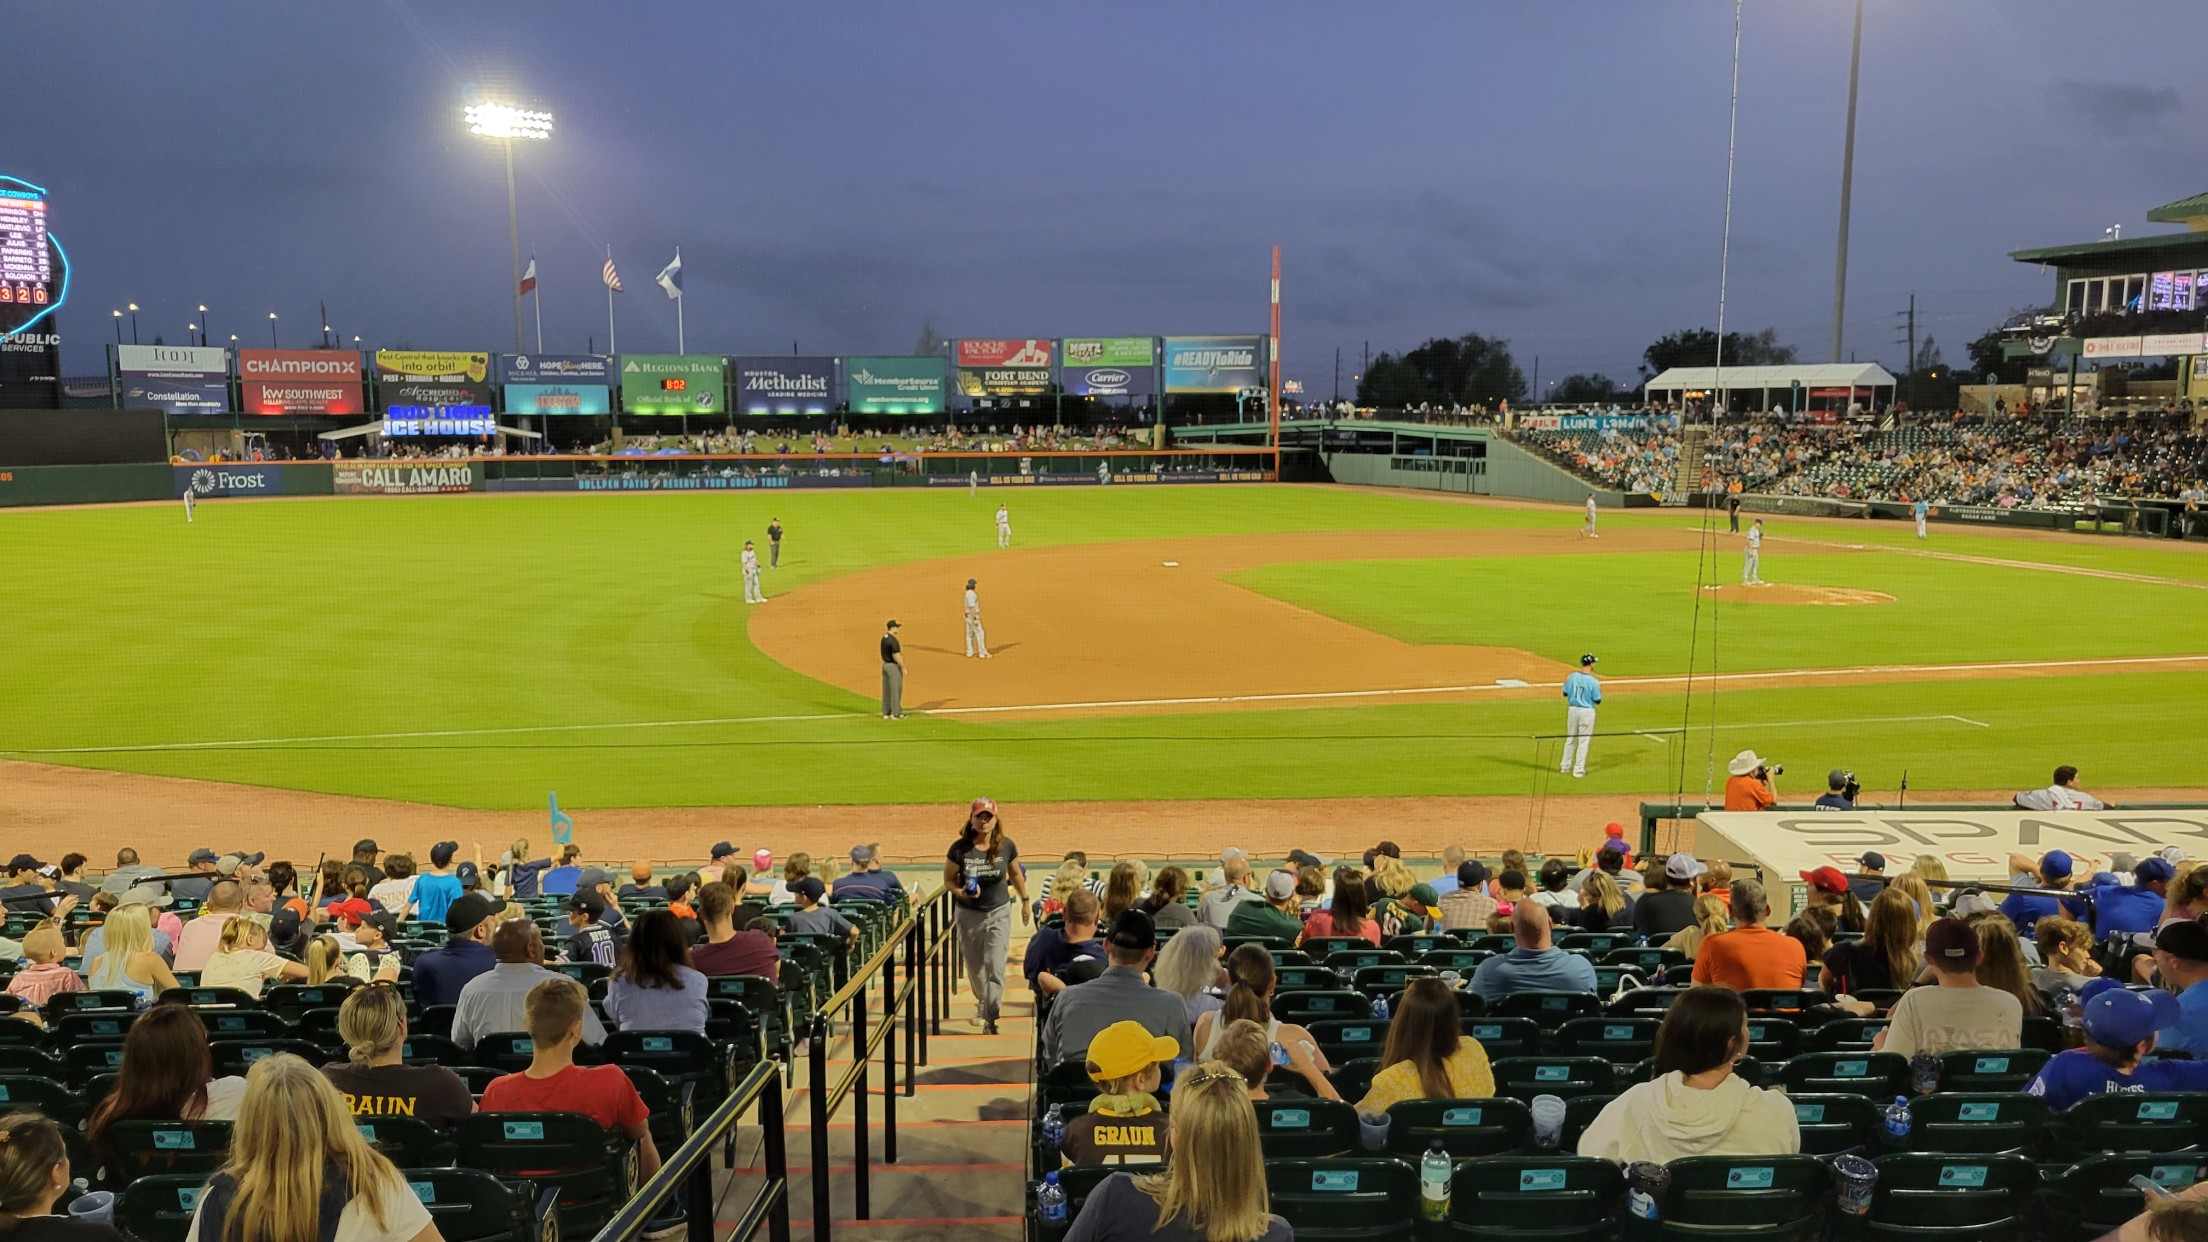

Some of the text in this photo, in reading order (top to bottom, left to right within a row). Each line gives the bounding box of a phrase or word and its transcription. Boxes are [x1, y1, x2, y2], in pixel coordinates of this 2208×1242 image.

[6, 190, 38, 199] COWBOYS
[5, 272, 36, 280] SOLOMON
[1, 288, 45, 302] 3 2 0
[1, 345, 44, 353] SERVICES
[395, 353, 421, 361] Control
[1173, 351, 1253, 367] #READYtoRide
[402, 361, 456, 371] into orbit!
[540, 361, 562, 369] HOPE
[643, 363, 719, 373] REGIONS BANK
[985, 371, 1049, 380] FORT BEND
[1091, 373, 1126, 382] Carrier
[666, 380, 686, 390] 8:02
[745, 374, 828, 390] Methodist
[874, 377, 939, 385] MemberSource
[147, 391, 200, 401] Constellation
[284, 390, 344, 400] SOUTHWEST
[388, 405, 491, 419] BUD LIGHT
[384, 420, 497, 436] ICE HOUSE
[217, 472, 265, 488] Frost
[362, 468, 472, 487] CALL AMARO
[579, 478, 788, 489] BULLPEN PATIO RESERVE YOUR GROUP TODAY
[1574, 686, 1585, 700] 17
[592, 941, 616, 968] 10
[1922, 1028, 2013, 1049] NASA
